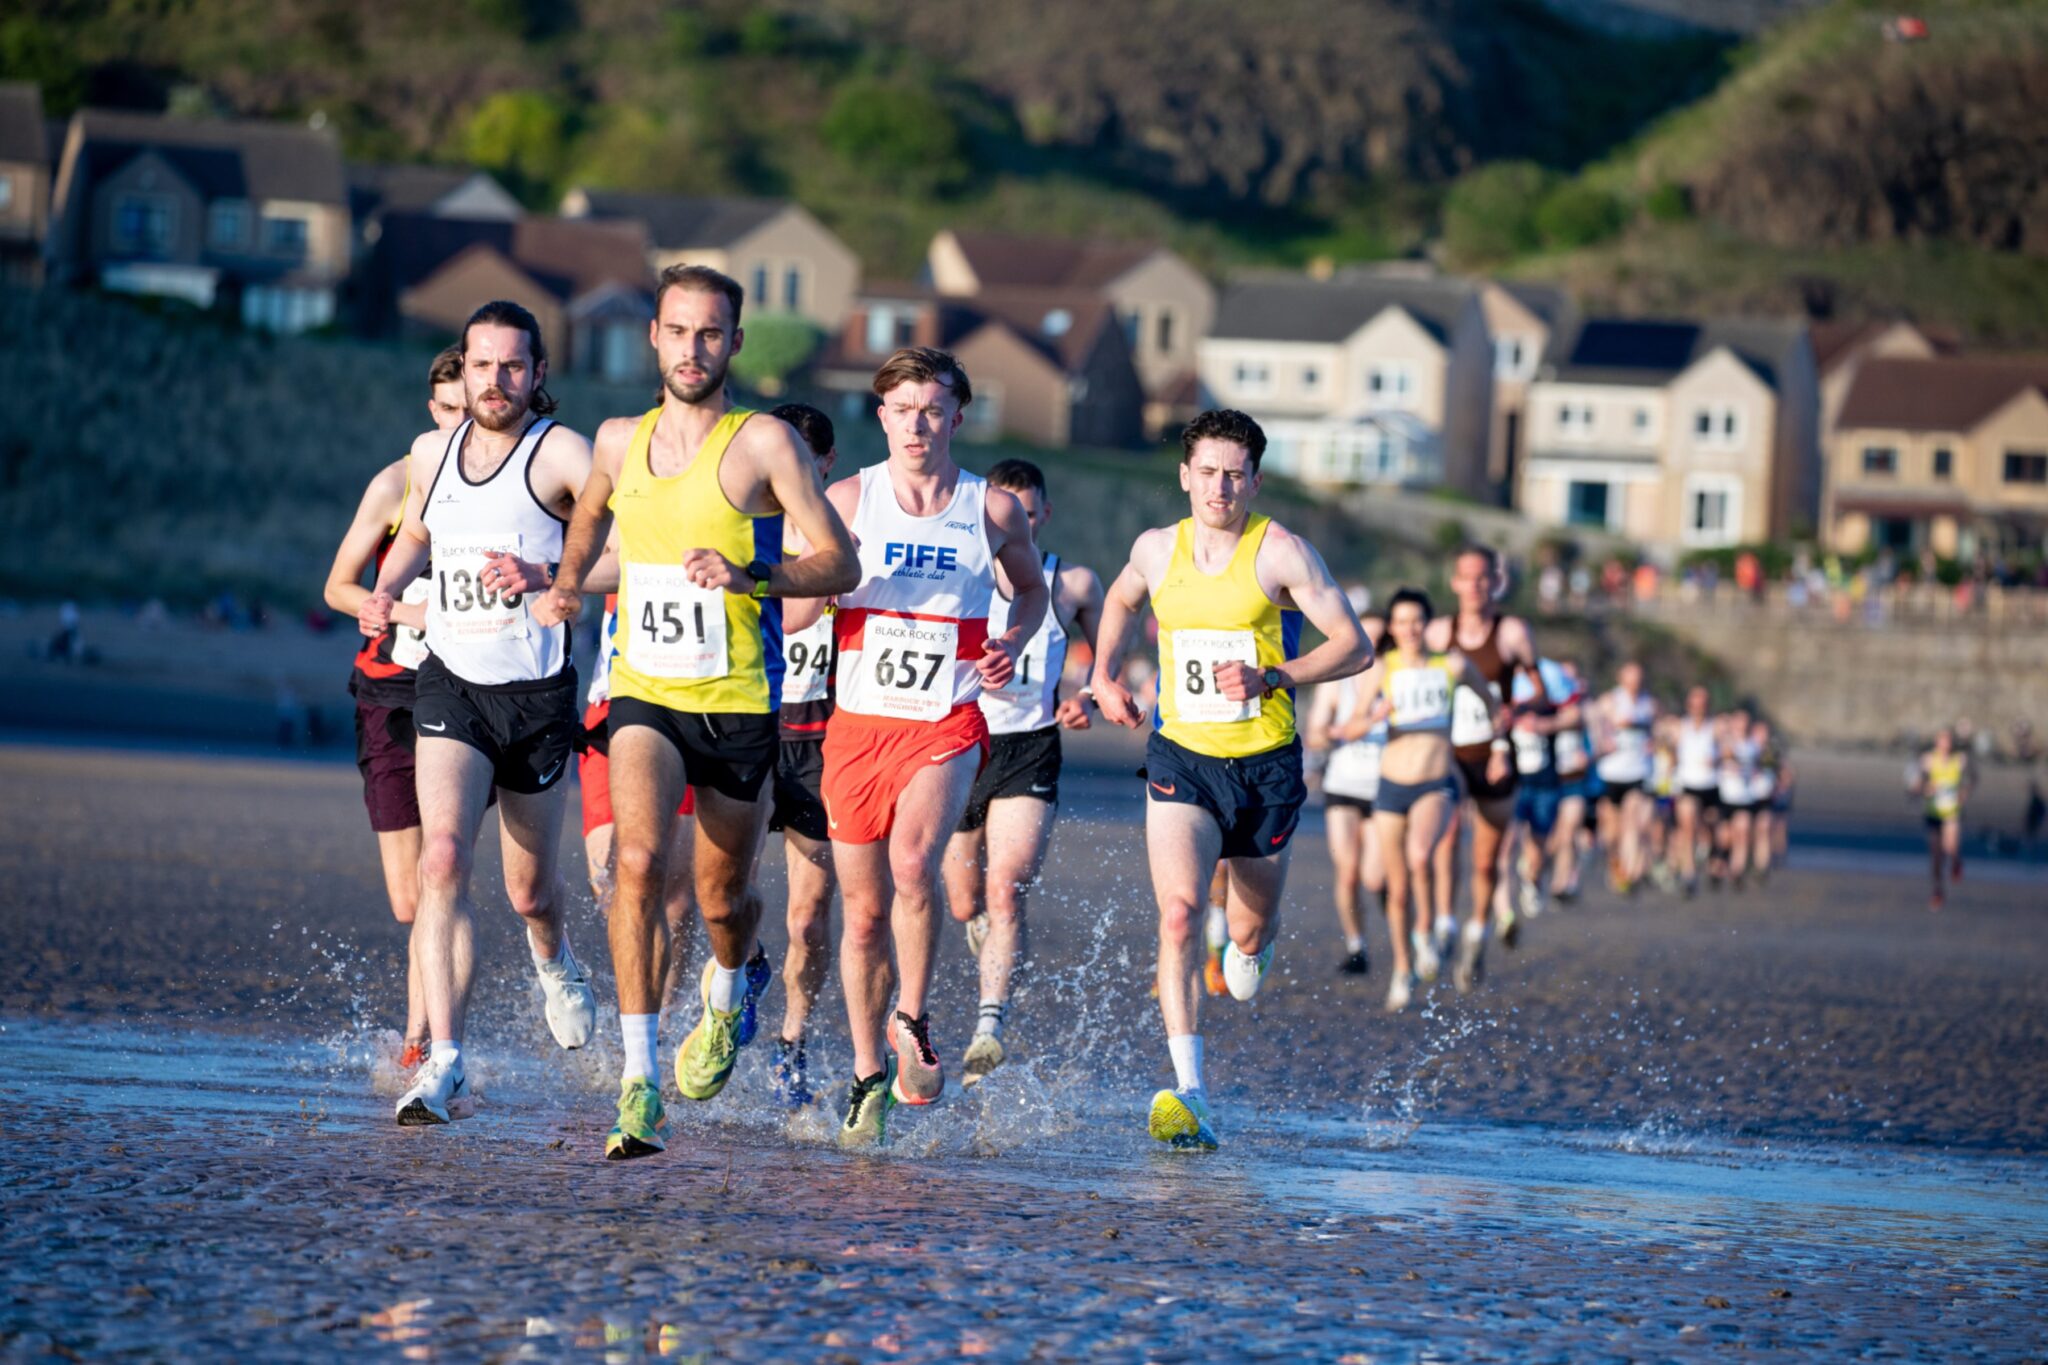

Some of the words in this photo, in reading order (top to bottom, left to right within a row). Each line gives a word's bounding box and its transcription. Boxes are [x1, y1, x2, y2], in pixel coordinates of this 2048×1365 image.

[884, 542, 957, 571] FIFE
[892, 567, 925, 579] athletic
[927, 570, 946, 581] club
[641, 600, 706, 644] 451
[874, 625, 907, 639] BLACK
[909, 629, 937, 642] ROCK
[874, 647, 946, 692] 657
